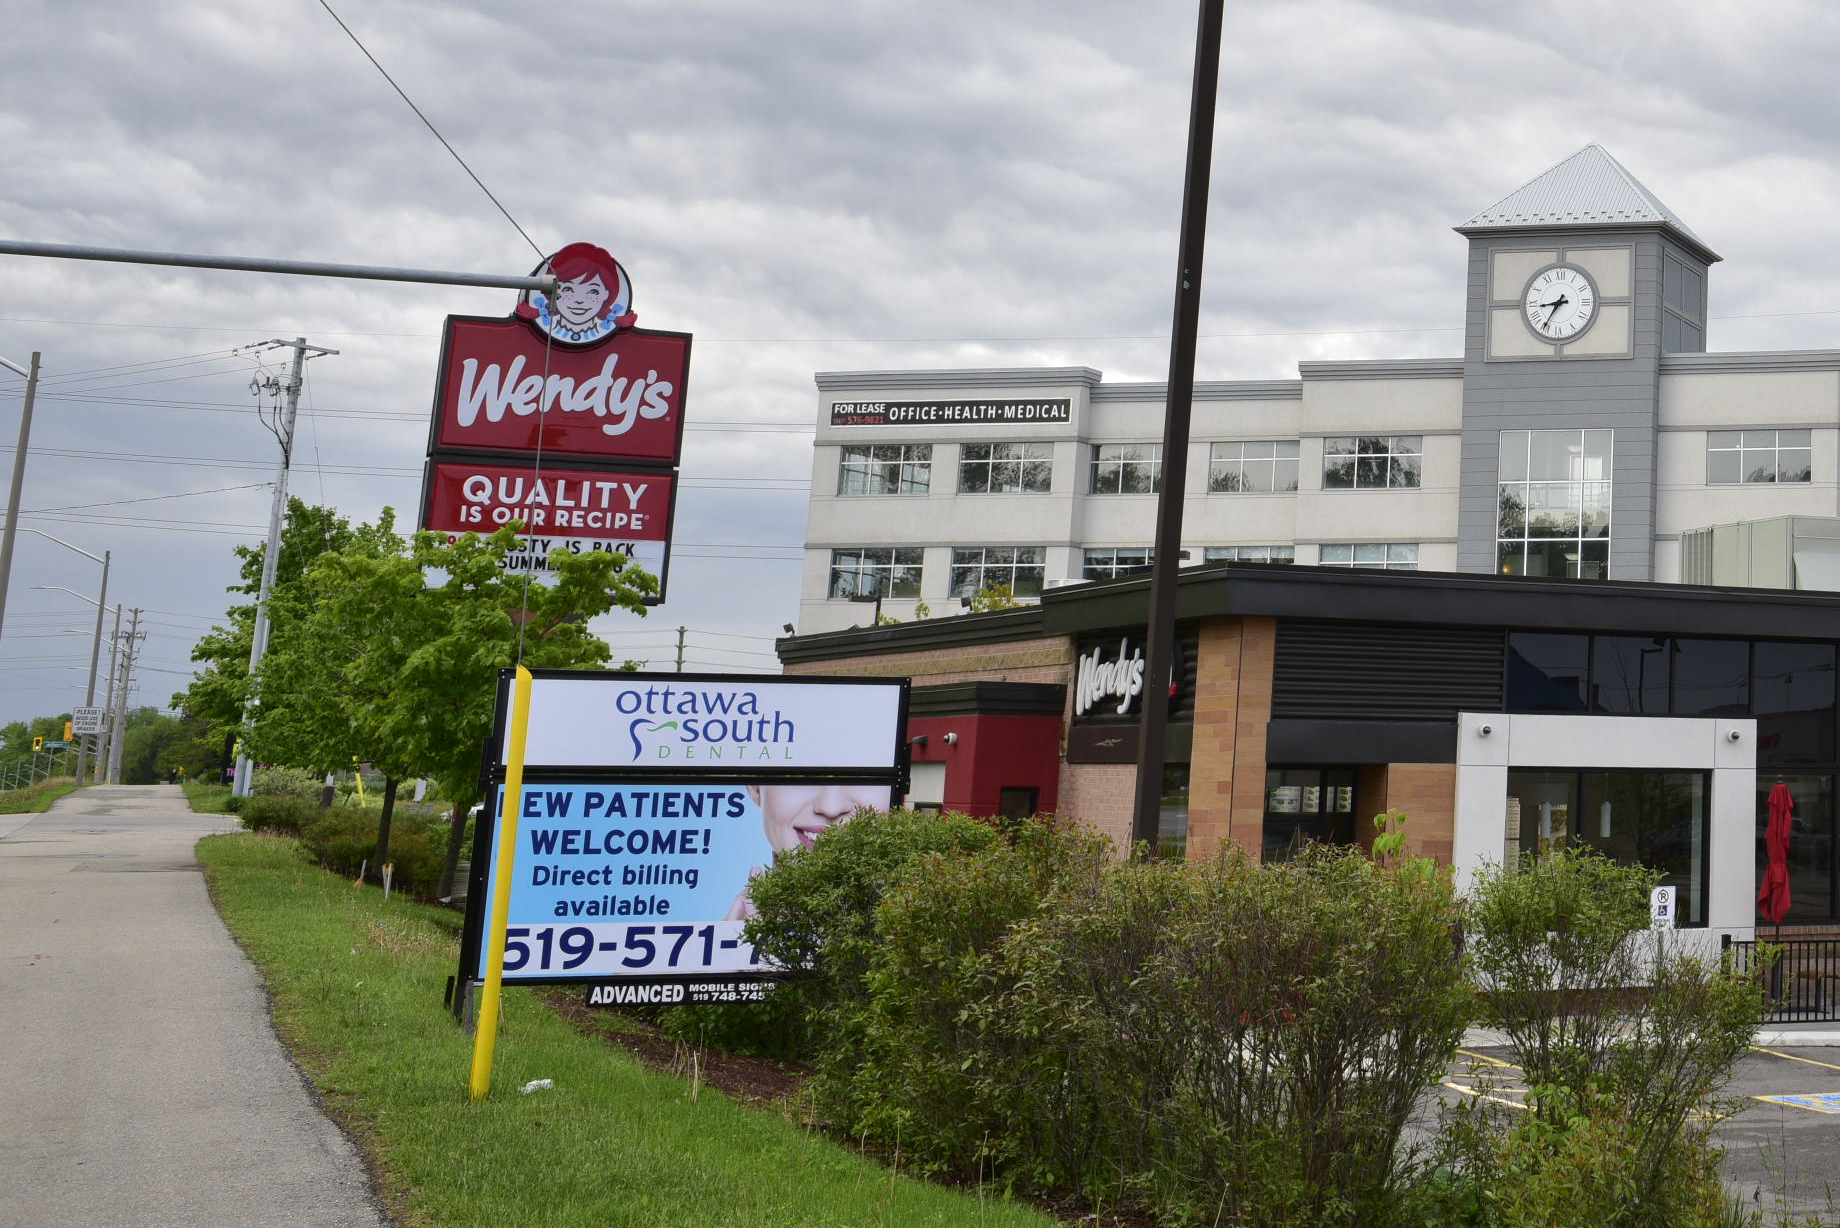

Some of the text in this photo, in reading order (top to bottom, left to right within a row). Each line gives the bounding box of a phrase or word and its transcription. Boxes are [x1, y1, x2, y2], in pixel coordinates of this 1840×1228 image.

[456, 352, 673, 436] Wendy's
[834, 403, 886, 414] FOR LEASE
[889, 403, 1067, 420] OFFICE HEALTH MEDICAL
[462, 474, 649, 510] QUALITY
[460, 505, 643, 531] IS OUR RECIPE
[1076, 637, 1145, 715] Wendy's
[615, 684, 760, 716] ottawa
[679, 711, 795, 744] south
[659, 745, 794, 760] DENTAL
[583, 791, 746, 818] PATIENTS
[531, 828, 712, 855] WELCOME!
[532, 863, 700, 890] Direct billing
[554, 894, 671, 917] available
[589, 985, 685, 1005] ADVANCED
[689, 983, 735, 992] MOBILE
[692, 993, 709, 1001] 519
